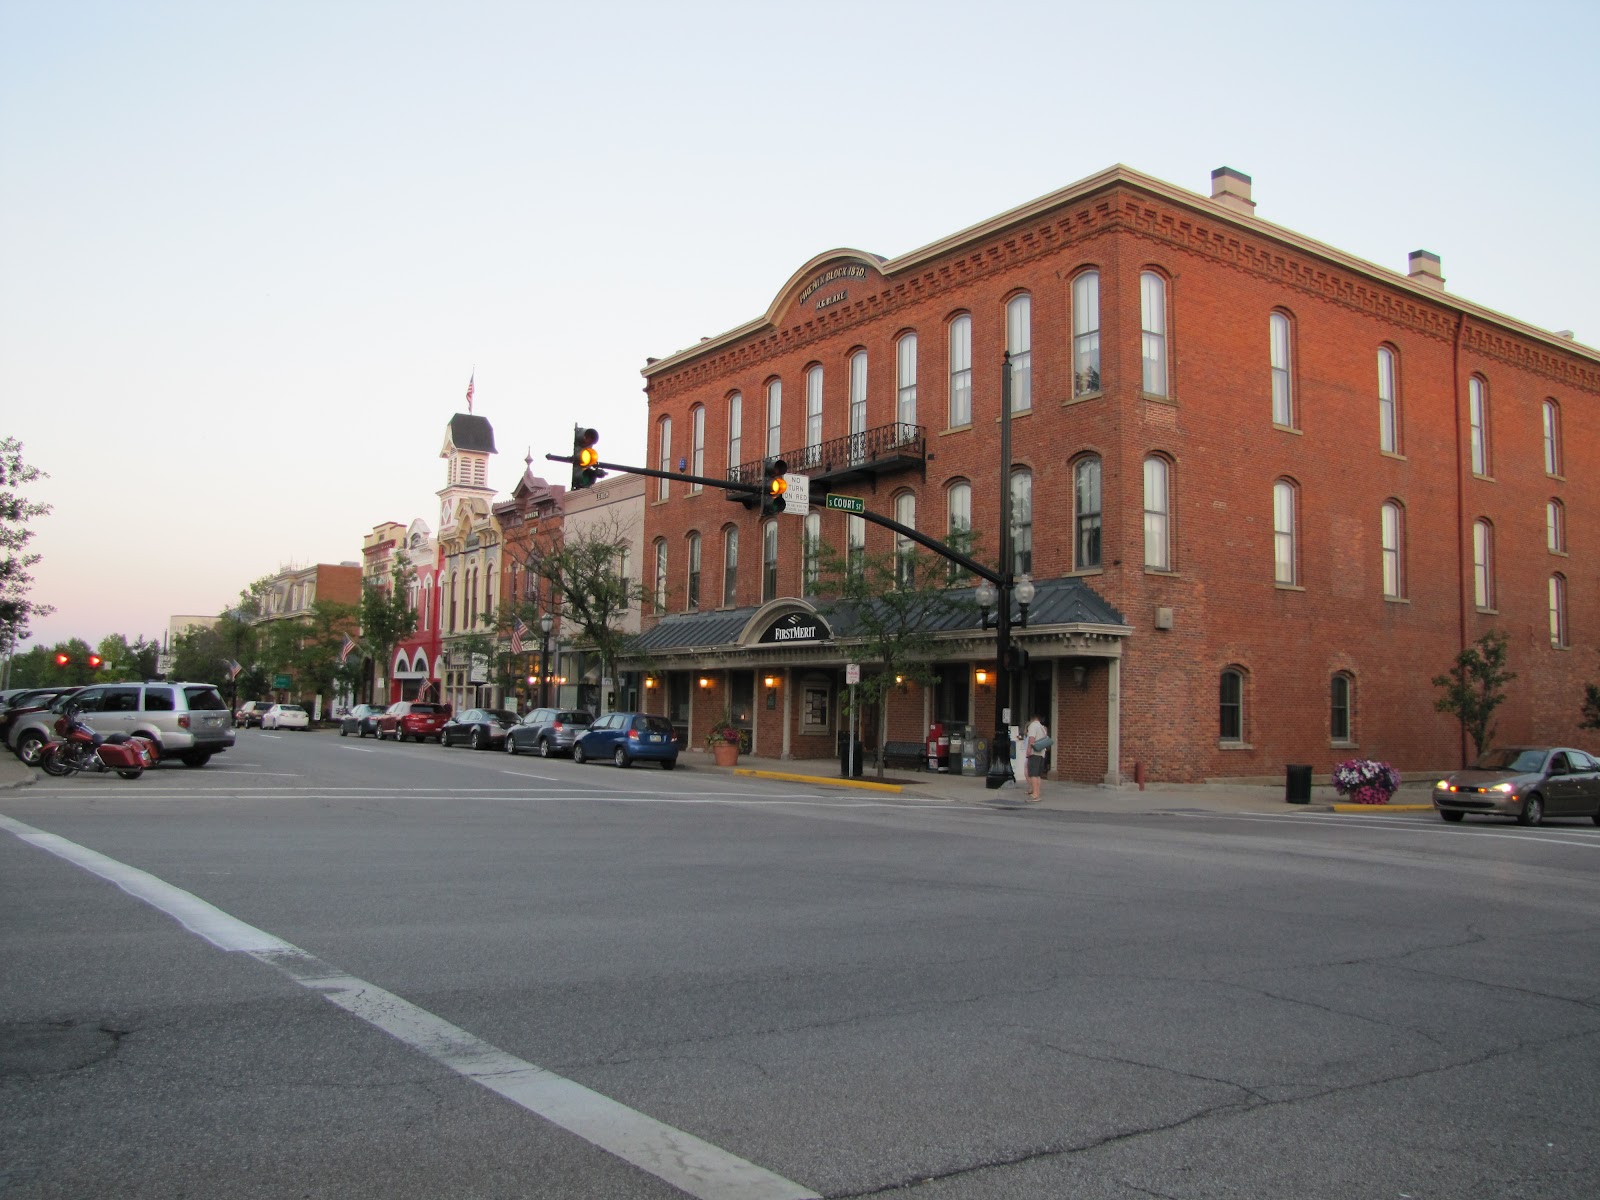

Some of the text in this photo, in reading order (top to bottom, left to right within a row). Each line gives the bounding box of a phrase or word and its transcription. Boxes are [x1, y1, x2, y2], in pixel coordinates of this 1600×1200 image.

[826, 267, 848, 281] BLOCK
[788, 484, 804, 492] TURN
[795, 493, 808, 501] RED
[829, 499, 833, 507] S
[834, 498, 855, 510] COURT
